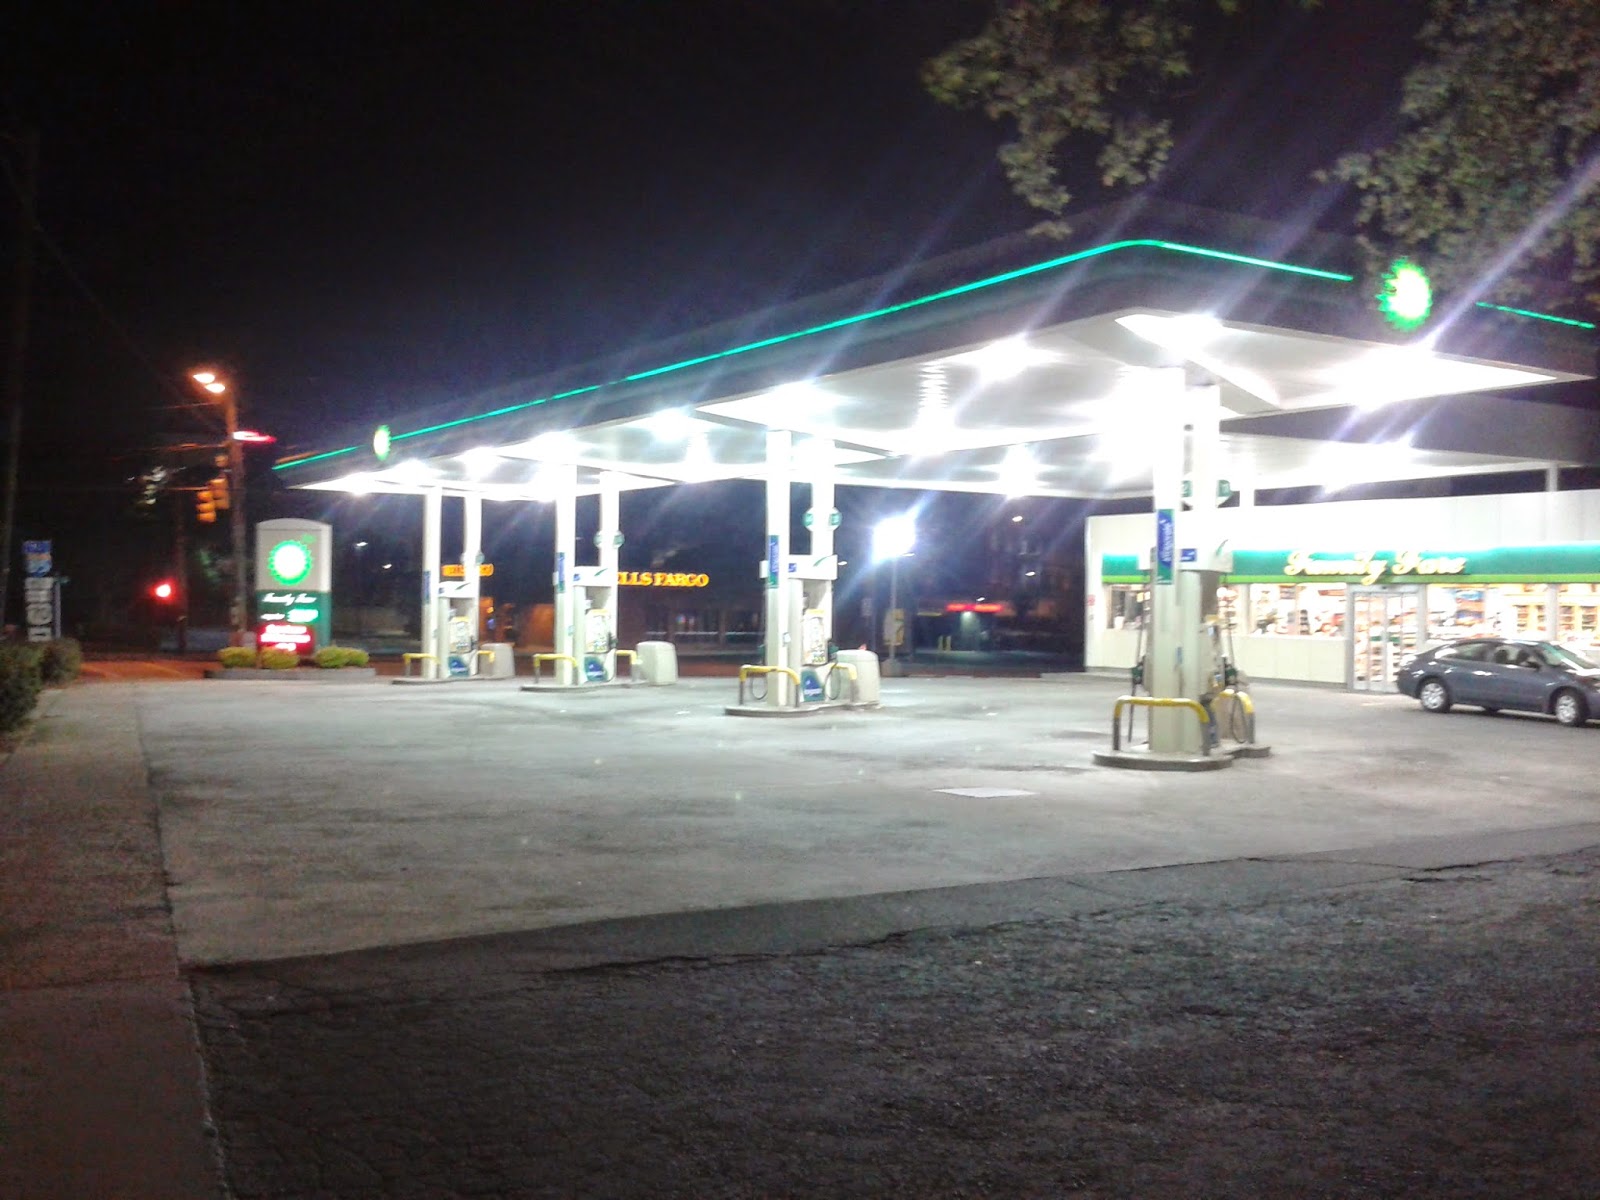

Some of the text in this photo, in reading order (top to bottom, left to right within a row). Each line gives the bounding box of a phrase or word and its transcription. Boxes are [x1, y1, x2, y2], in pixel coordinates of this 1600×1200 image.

[653, 572, 710, 587] FARGO
[1284, 550, 1467, 586] Family Fare
